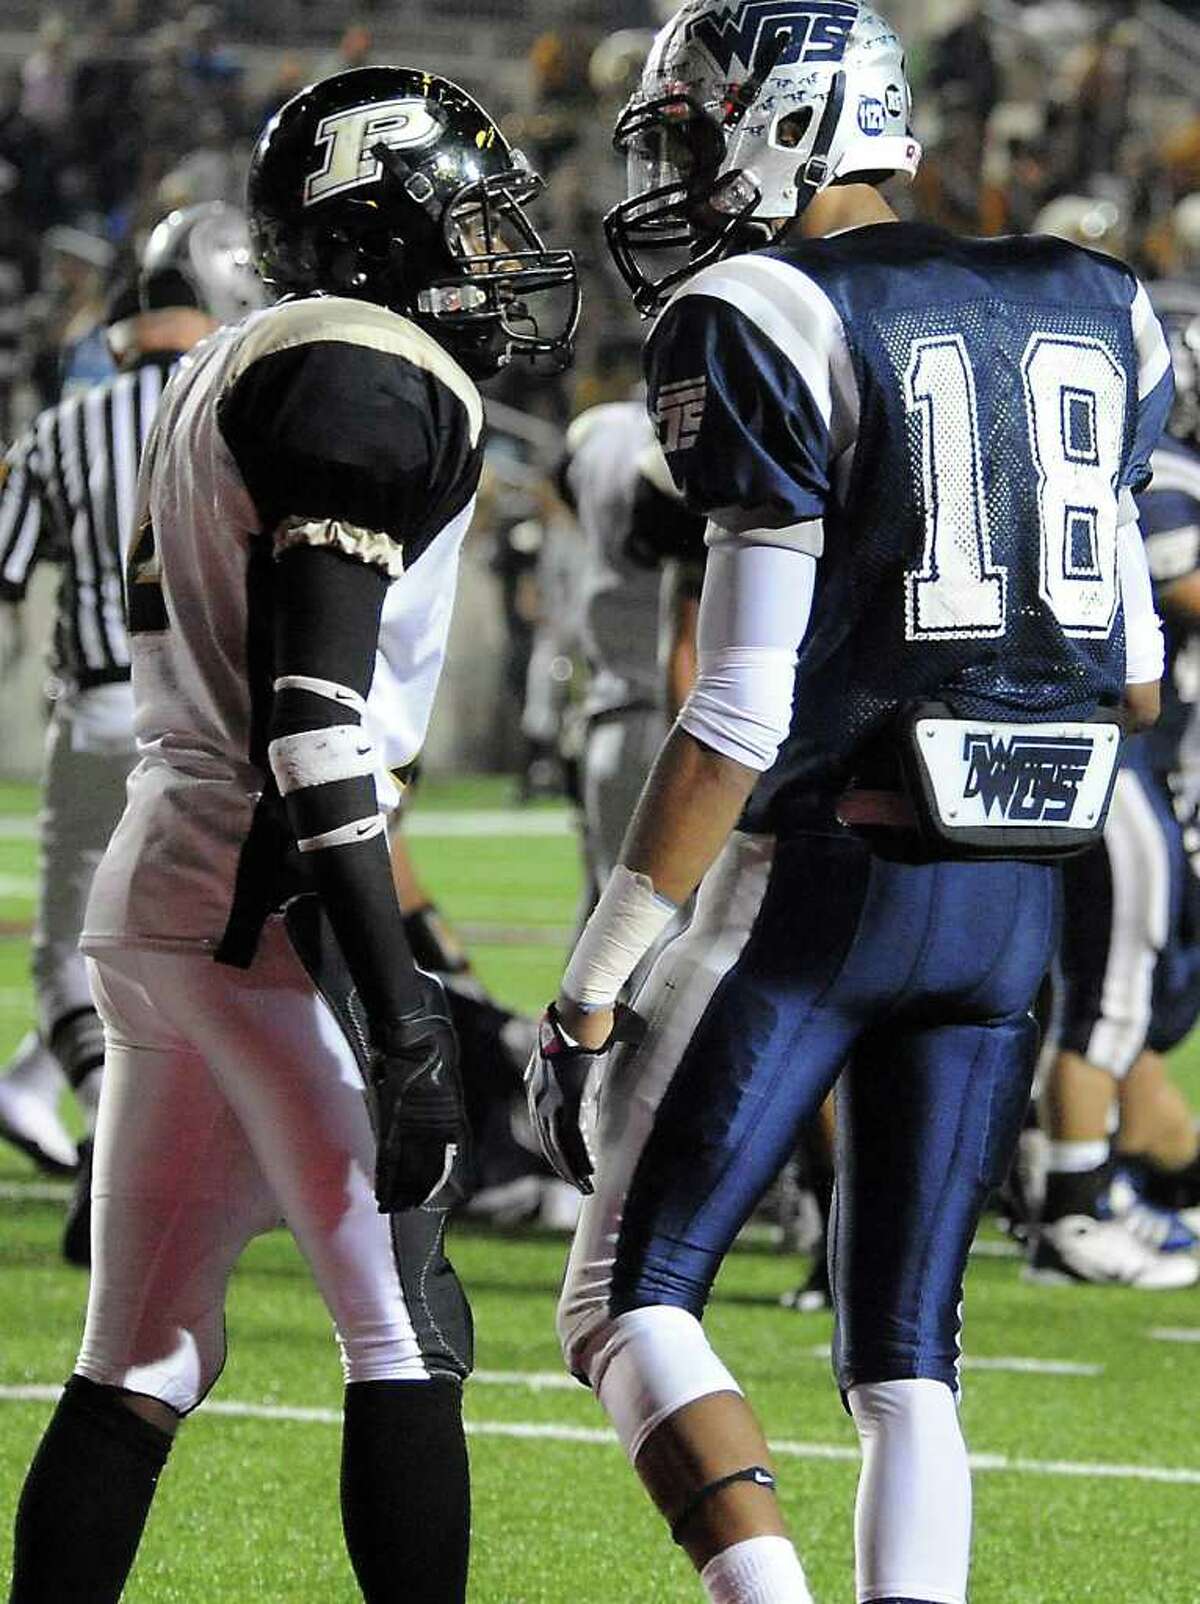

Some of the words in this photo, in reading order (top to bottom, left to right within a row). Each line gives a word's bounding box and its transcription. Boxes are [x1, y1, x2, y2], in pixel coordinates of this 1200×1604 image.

[684, 0, 858, 77] WOS
[303, 98, 441, 206] P
[902, 331, 1128, 641] 18
